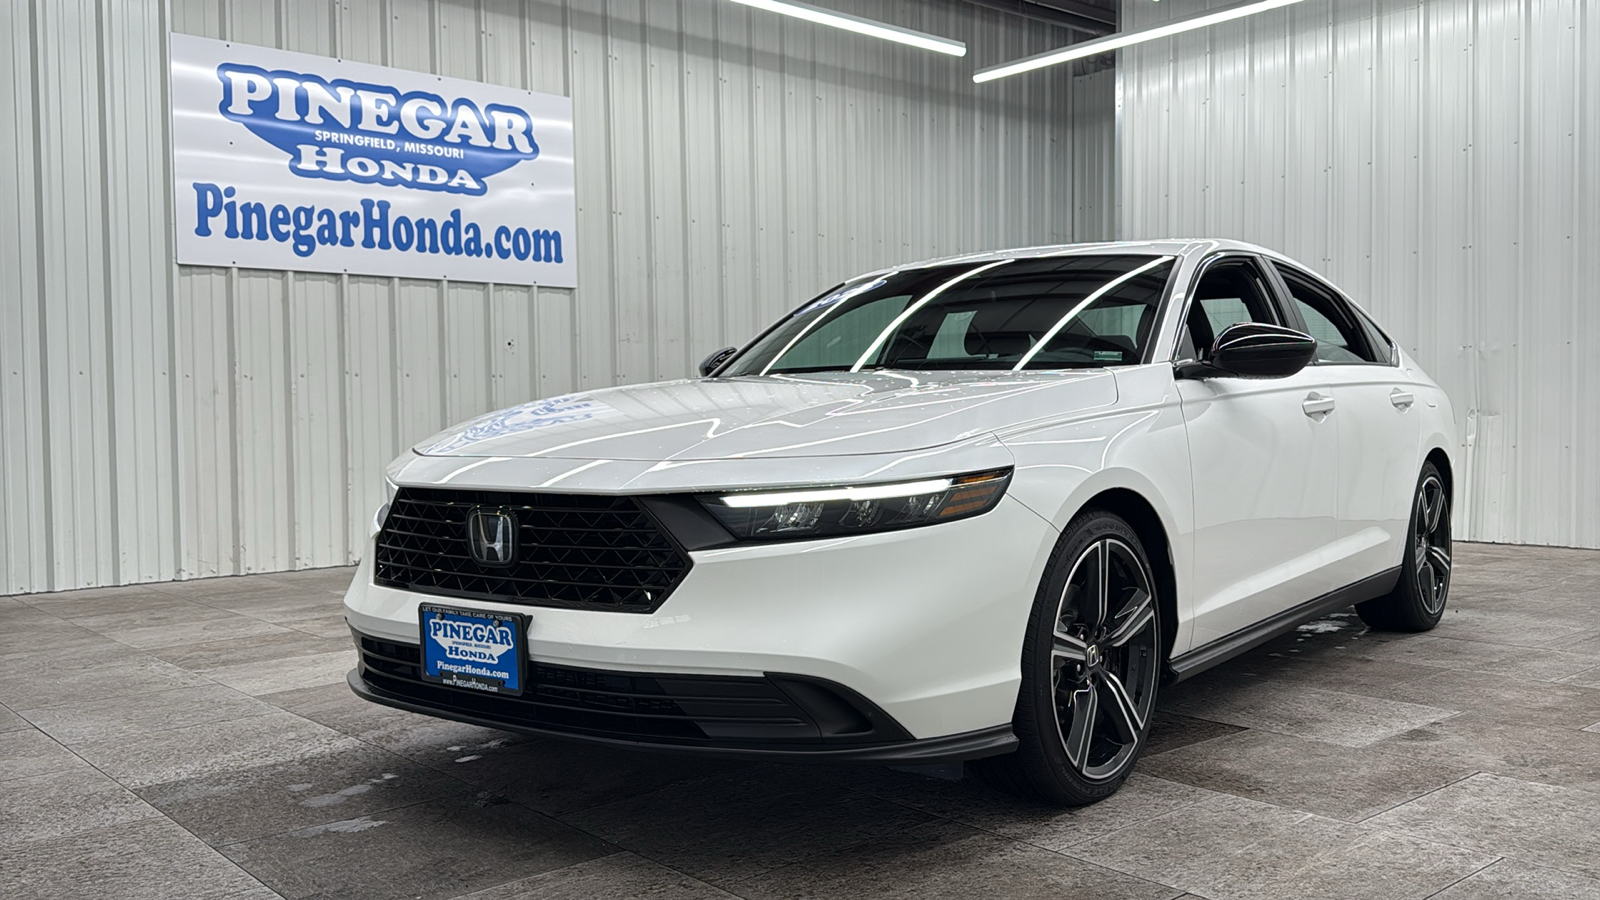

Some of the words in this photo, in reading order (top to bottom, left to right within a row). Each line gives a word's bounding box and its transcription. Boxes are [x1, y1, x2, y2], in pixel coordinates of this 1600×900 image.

[224, 70, 534, 154] PINEGAR
[314, 129, 401, 153] SPRINGFIELD,
[404, 142, 465, 159] MISSOURI
[296, 144, 481, 190] HONDA
[192, 182, 564, 264] PinegarHonda.com
[431, 621, 512, 647] PINEGAR
[448, 646, 496, 661] HONDA
[437, 660, 509, 679] PinegarHonda.com
